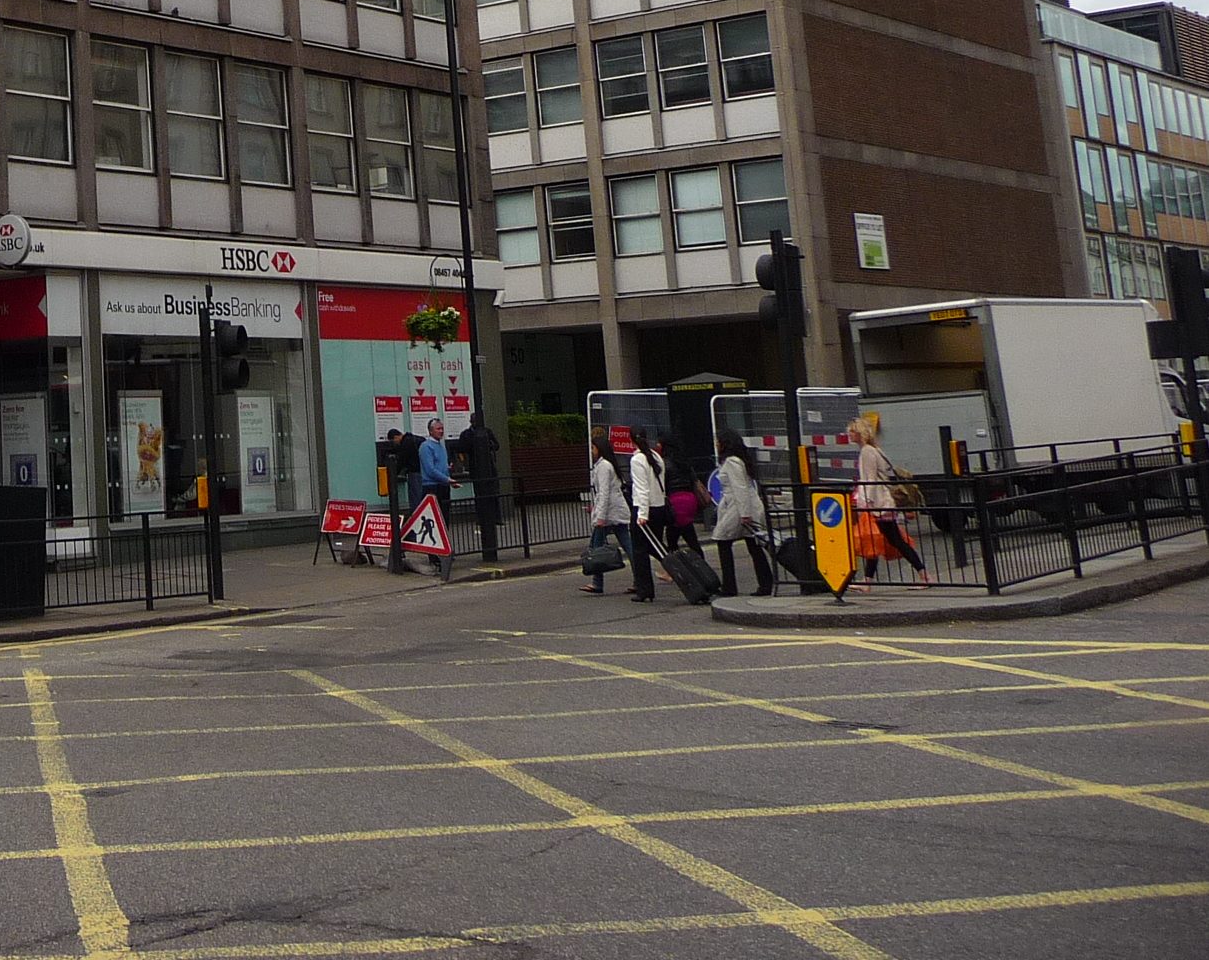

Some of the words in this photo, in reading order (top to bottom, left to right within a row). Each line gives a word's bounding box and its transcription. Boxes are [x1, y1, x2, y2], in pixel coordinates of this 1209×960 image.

[220, 247, 270, 272] HSBC
[318, 291, 334, 302] Free
[106, 300, 123, 313] Ask
[124, 303, 135, 314] us
[137, 302, 161, 315] about
[511, 347, 525, 365] 50
[407, 358, 431, 372] cash
[441, 358, 463, 372] cash
[19, 465, 28, 482] 0
